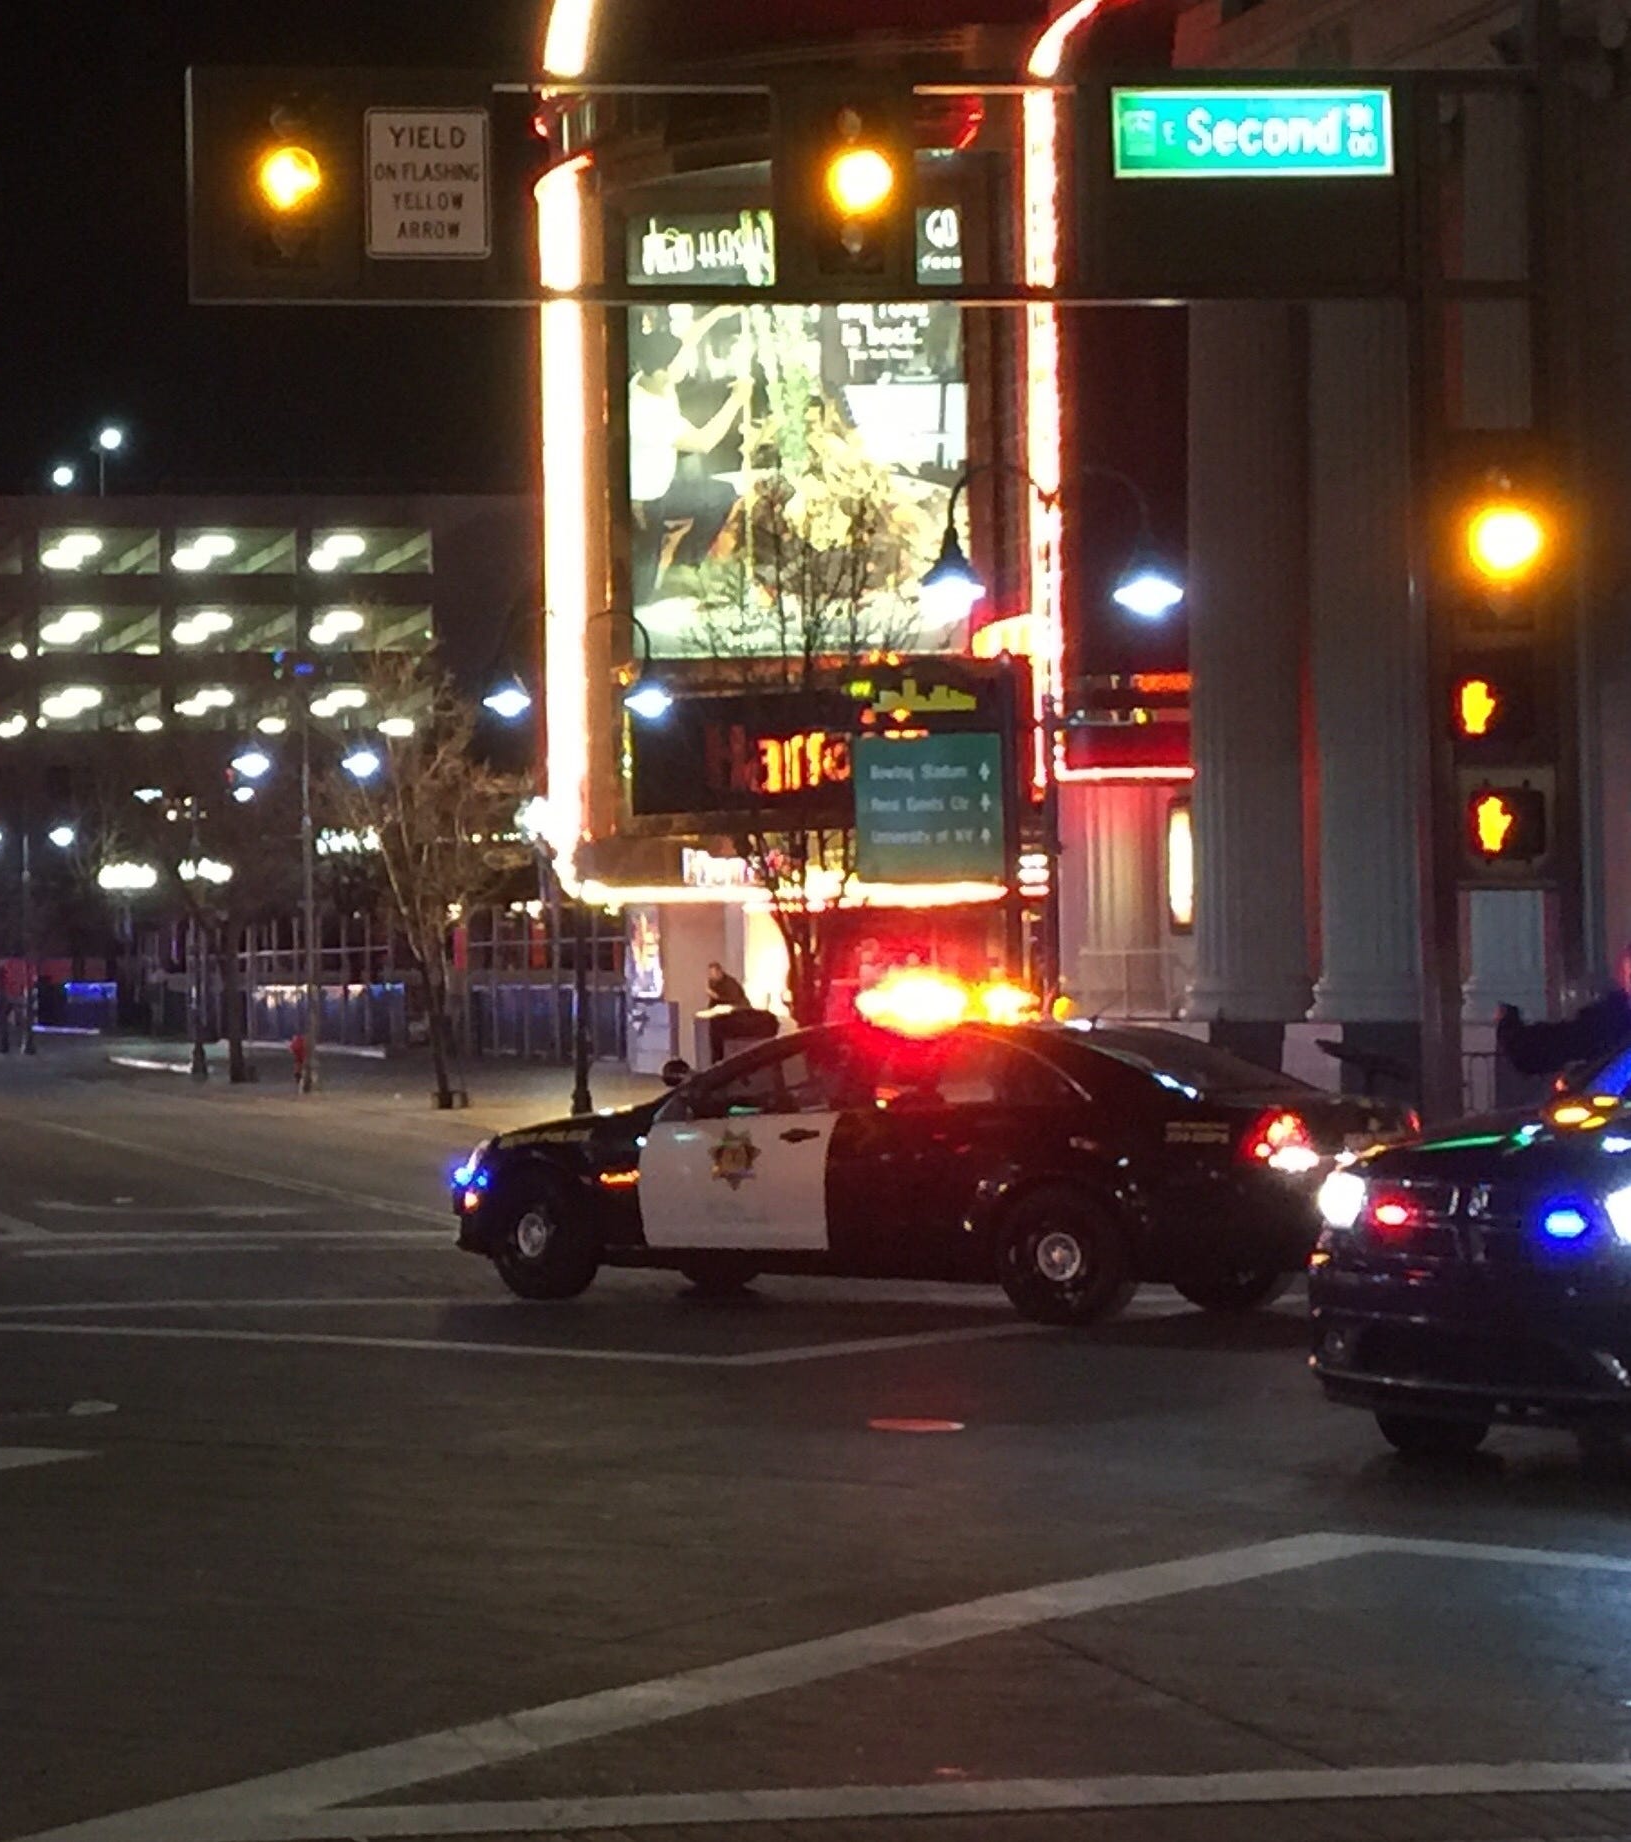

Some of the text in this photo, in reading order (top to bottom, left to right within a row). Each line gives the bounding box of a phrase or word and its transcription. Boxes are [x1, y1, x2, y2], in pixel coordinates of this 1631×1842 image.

[388, 125, 467, 150] YIELD
[1186, 105, 1344, 157] Second
[373, 162, 480, 182] ON FLASHING
[391, 191, 464, 211] YELLOW
[396, 220, 461, 240] ARROW
